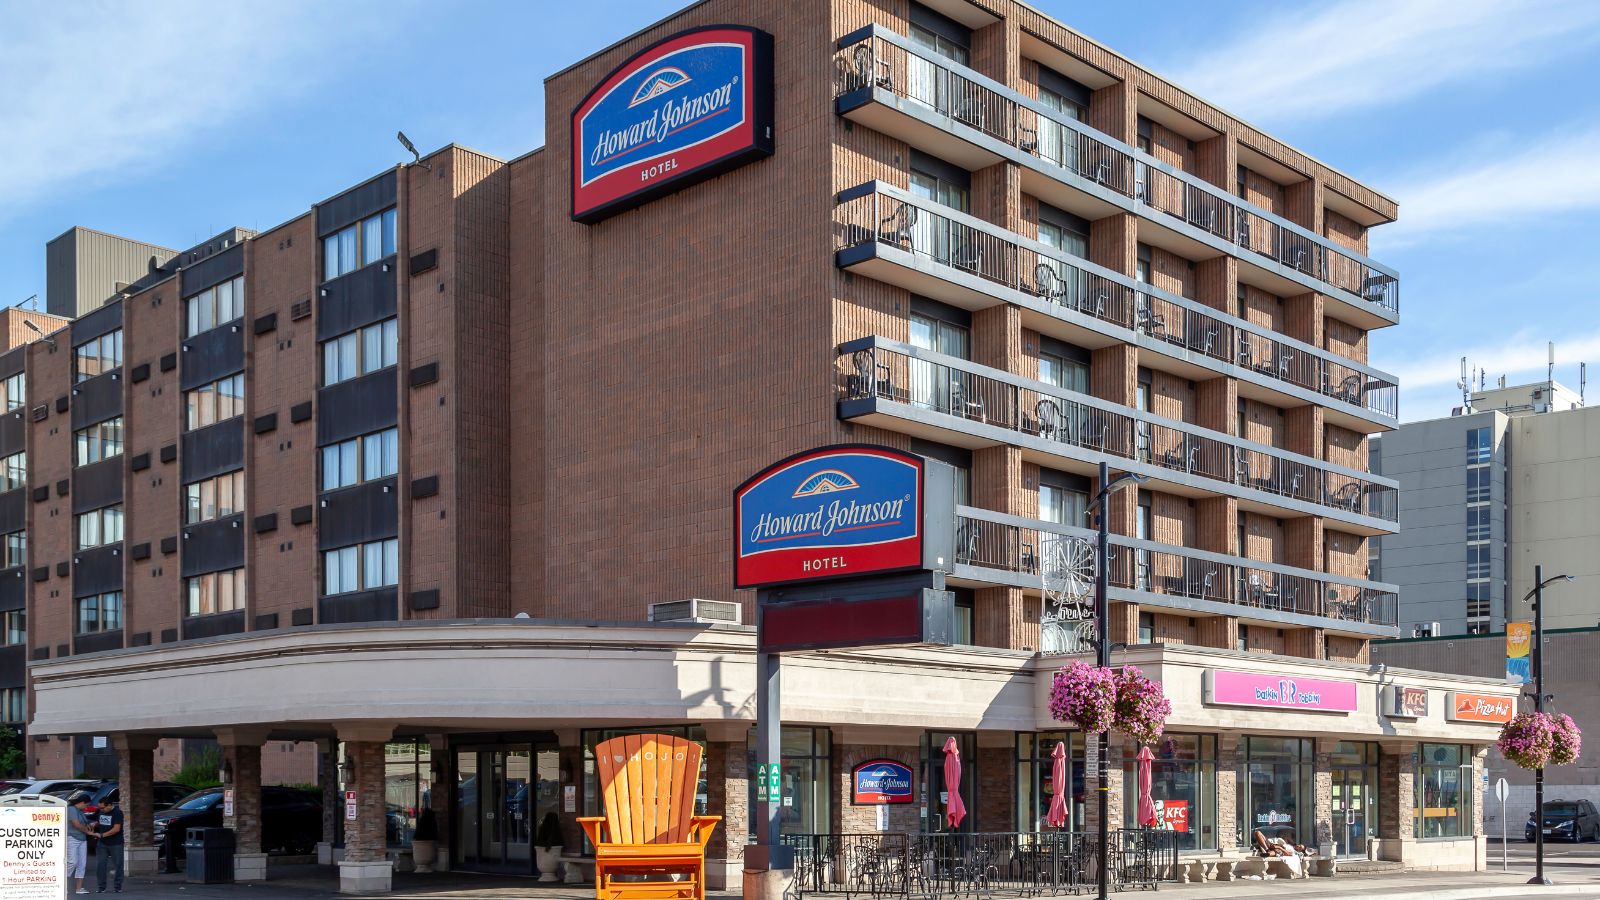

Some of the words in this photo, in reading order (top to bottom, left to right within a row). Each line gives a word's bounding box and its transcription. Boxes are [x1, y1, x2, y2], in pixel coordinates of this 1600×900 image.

[591, 108, 658, 166] Howard
[641, 158, 678, 181] HOTEL
[750, 504, 824, 543] Howard
[803, 556, 847, 571] HOTEL
[1407, 692, 1425, 706] KFC
[1475, 698, 1496, 716] Pizza
[1495, 701, 1510, 717] Hut
[758, 765, 767, 795] ATM
[771, 765, 779, 795] ATM
[860, 779, 884, 789] Howard
[885, 778, 909, 790] Johnson
[32, 812, 60, 822] Denny's
[1166, 807, 1186, 819] KFC
[0, 828, 60, 838] CUSTOMER
[5, 839, 53, 849] PARKING
[17, 850, 45, 860] ONLY
